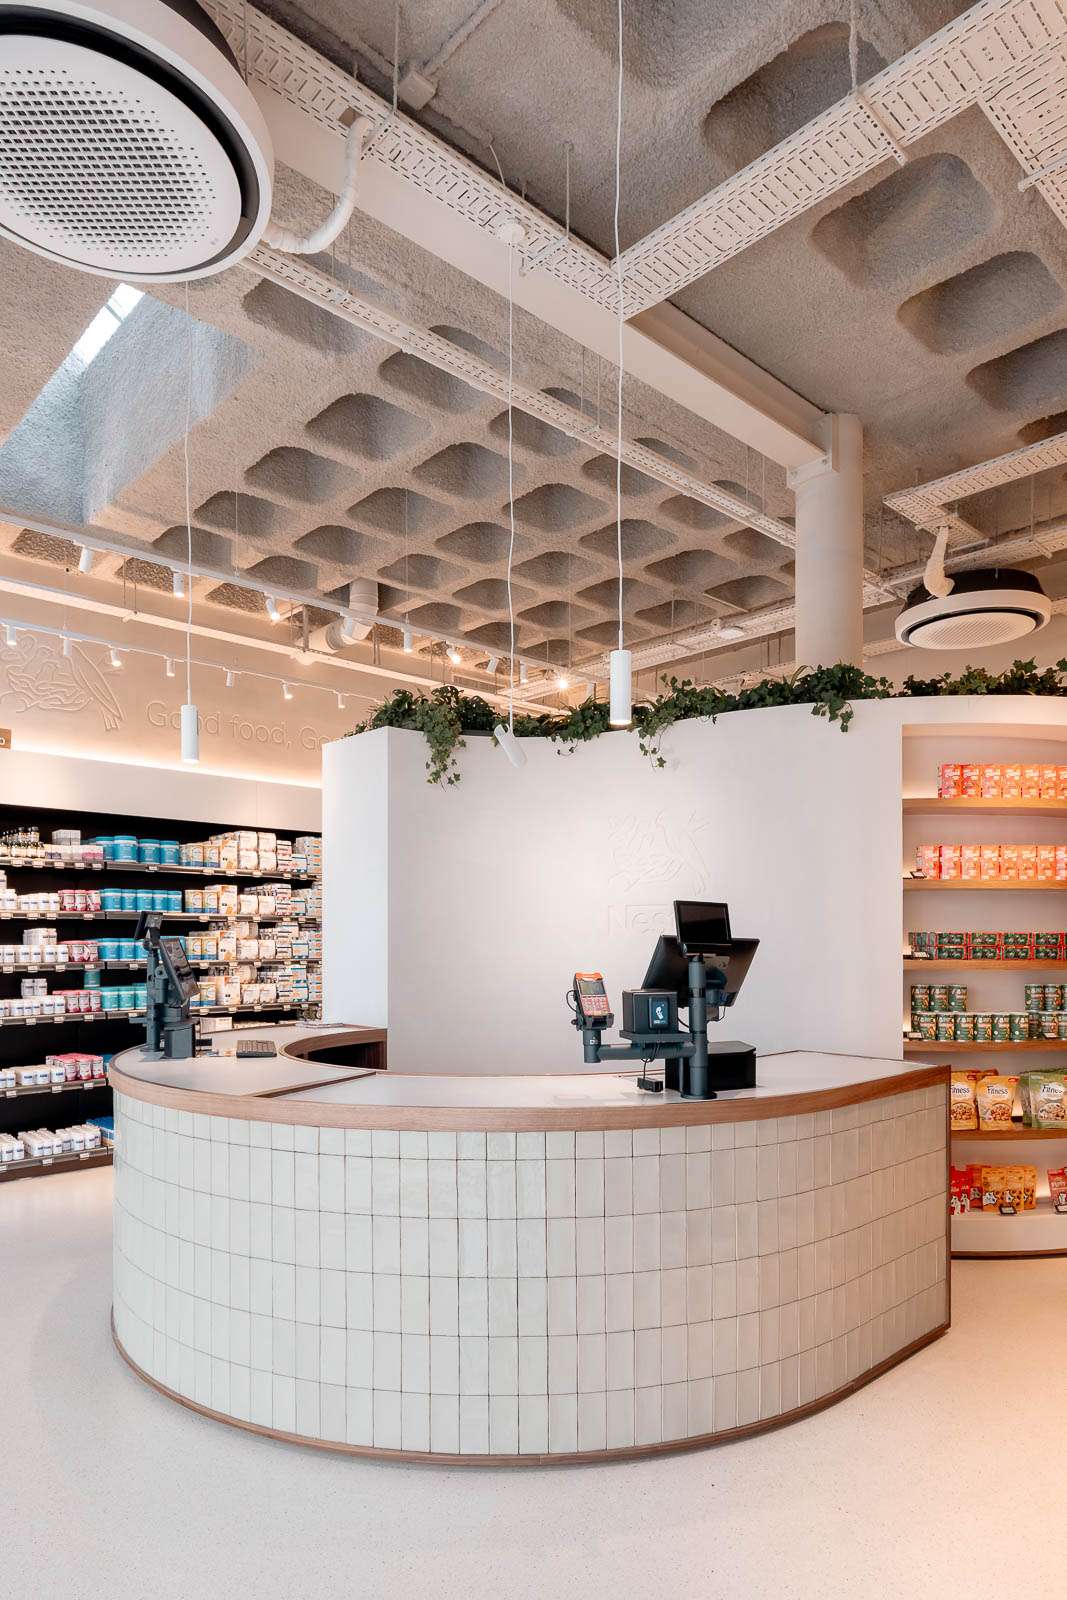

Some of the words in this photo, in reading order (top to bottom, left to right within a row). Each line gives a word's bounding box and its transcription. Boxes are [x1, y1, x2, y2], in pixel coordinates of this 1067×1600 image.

[146, 700, 221, 737] God
[228, 713, 293, 750] food,
[300, 725, 341, 751] Go
[986, 1085, 1009, 1095] Fitness
